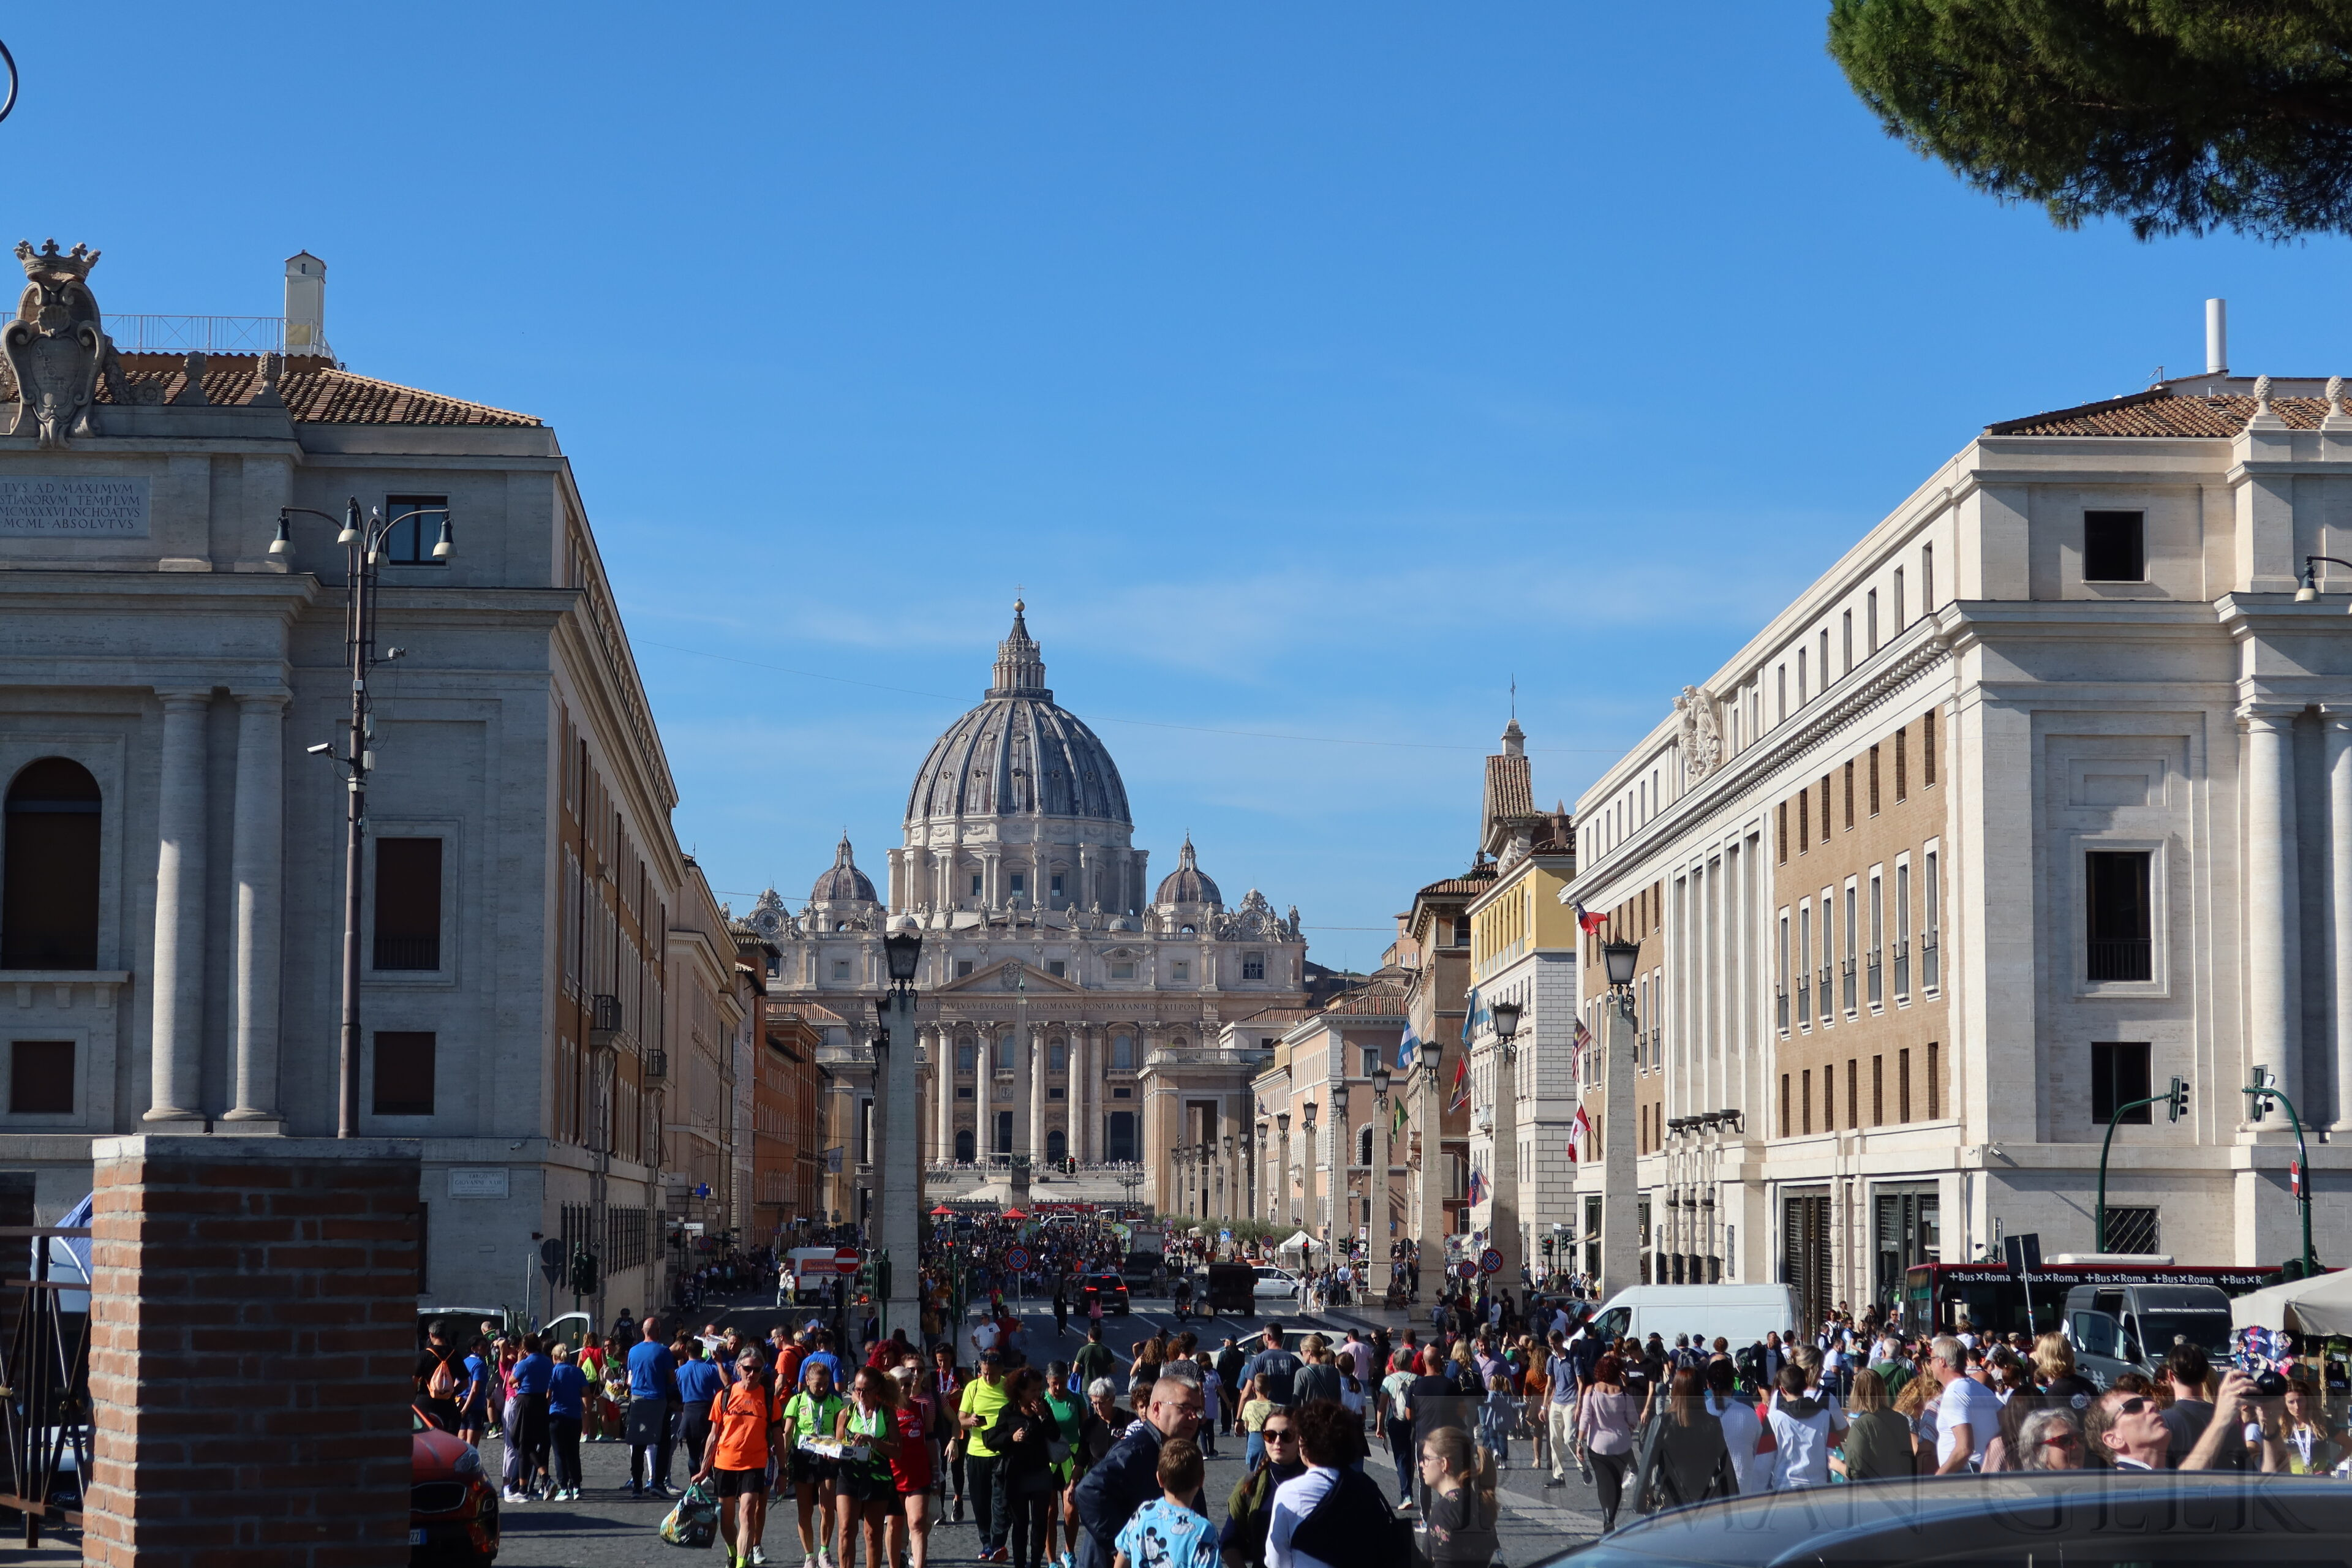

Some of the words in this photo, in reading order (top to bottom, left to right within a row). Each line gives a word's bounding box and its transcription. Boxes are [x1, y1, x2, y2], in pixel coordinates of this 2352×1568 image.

[35, 483, 54, 493] AD
[61, 483, 133, 494] MAXIMVM
[77, 496, 140, 505] TEMPLVM
[69, 507, 140, 518] INCHOATVS
[52, 519, 134, 529] ABSOLVTVS
